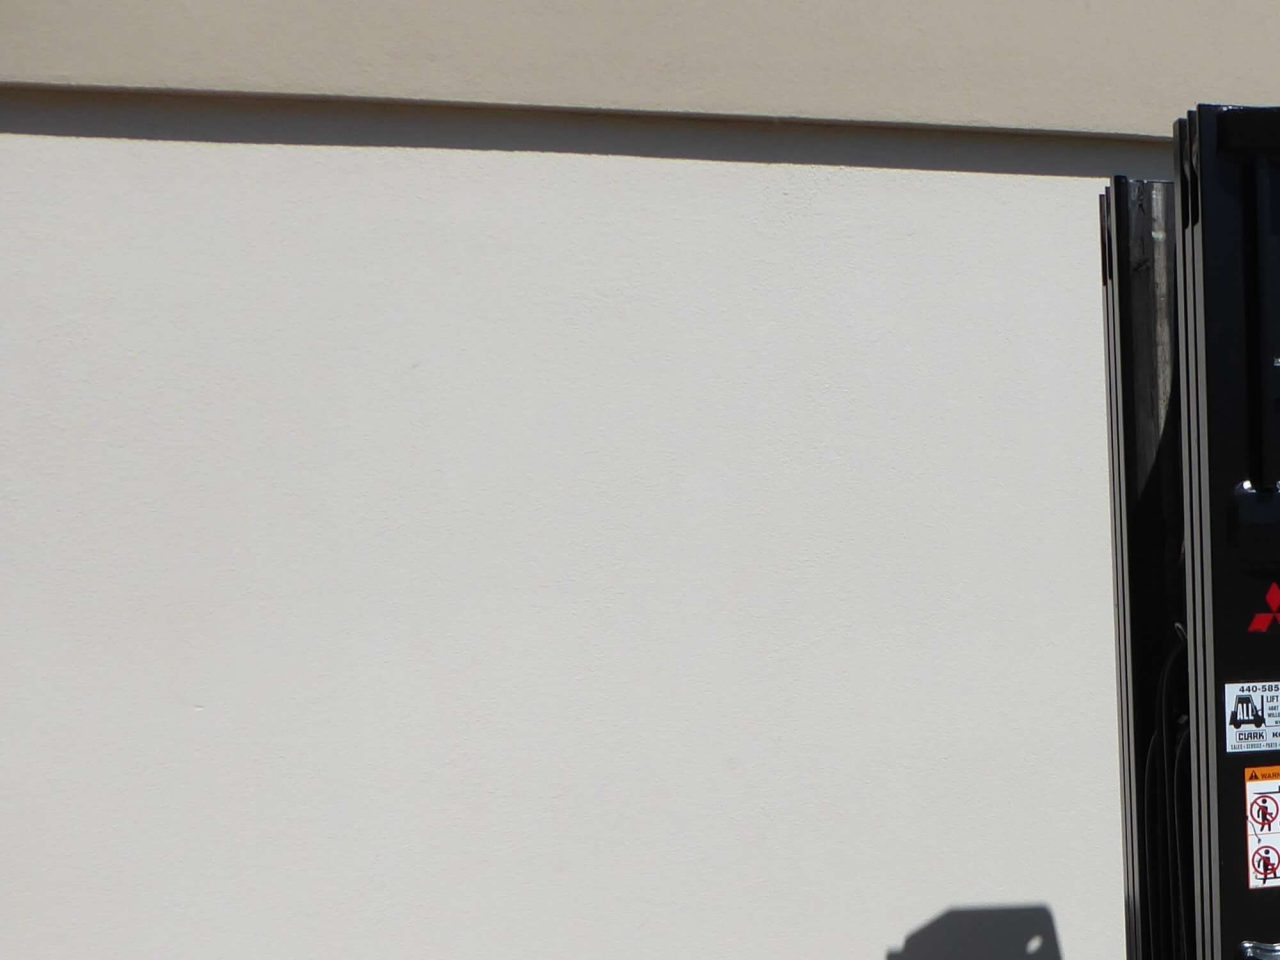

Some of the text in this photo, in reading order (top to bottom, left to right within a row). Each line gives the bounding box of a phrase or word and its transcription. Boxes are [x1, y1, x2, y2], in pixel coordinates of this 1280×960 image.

[1266, 695, 1279, 703] LIFT
[1237, 703, 1254, 720] ALL
[1238, 731, 1264, 741] CLARK
